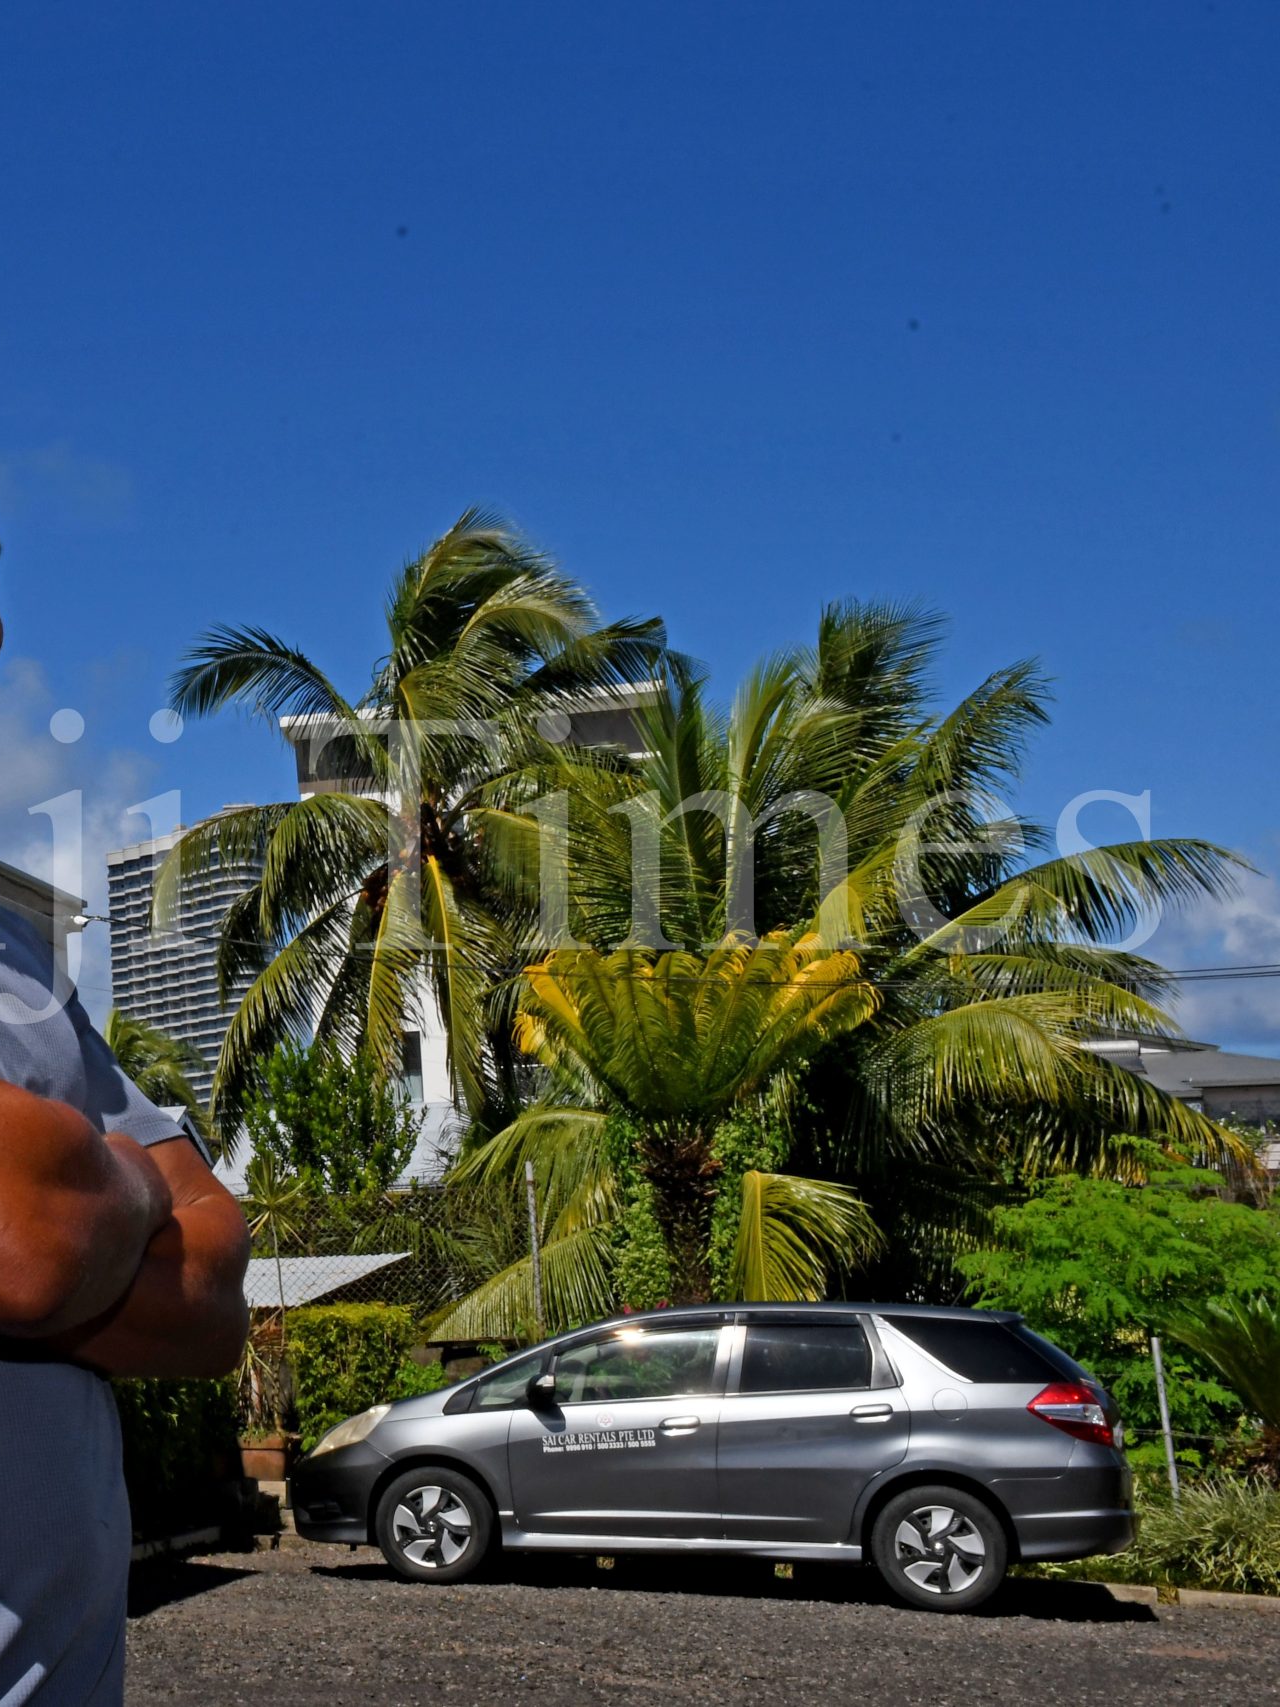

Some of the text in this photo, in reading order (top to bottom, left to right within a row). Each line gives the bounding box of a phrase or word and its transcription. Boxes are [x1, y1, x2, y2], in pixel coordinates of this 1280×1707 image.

[542, 1429, 655, 1446] SAI CAR RENTALS PTE LTD
